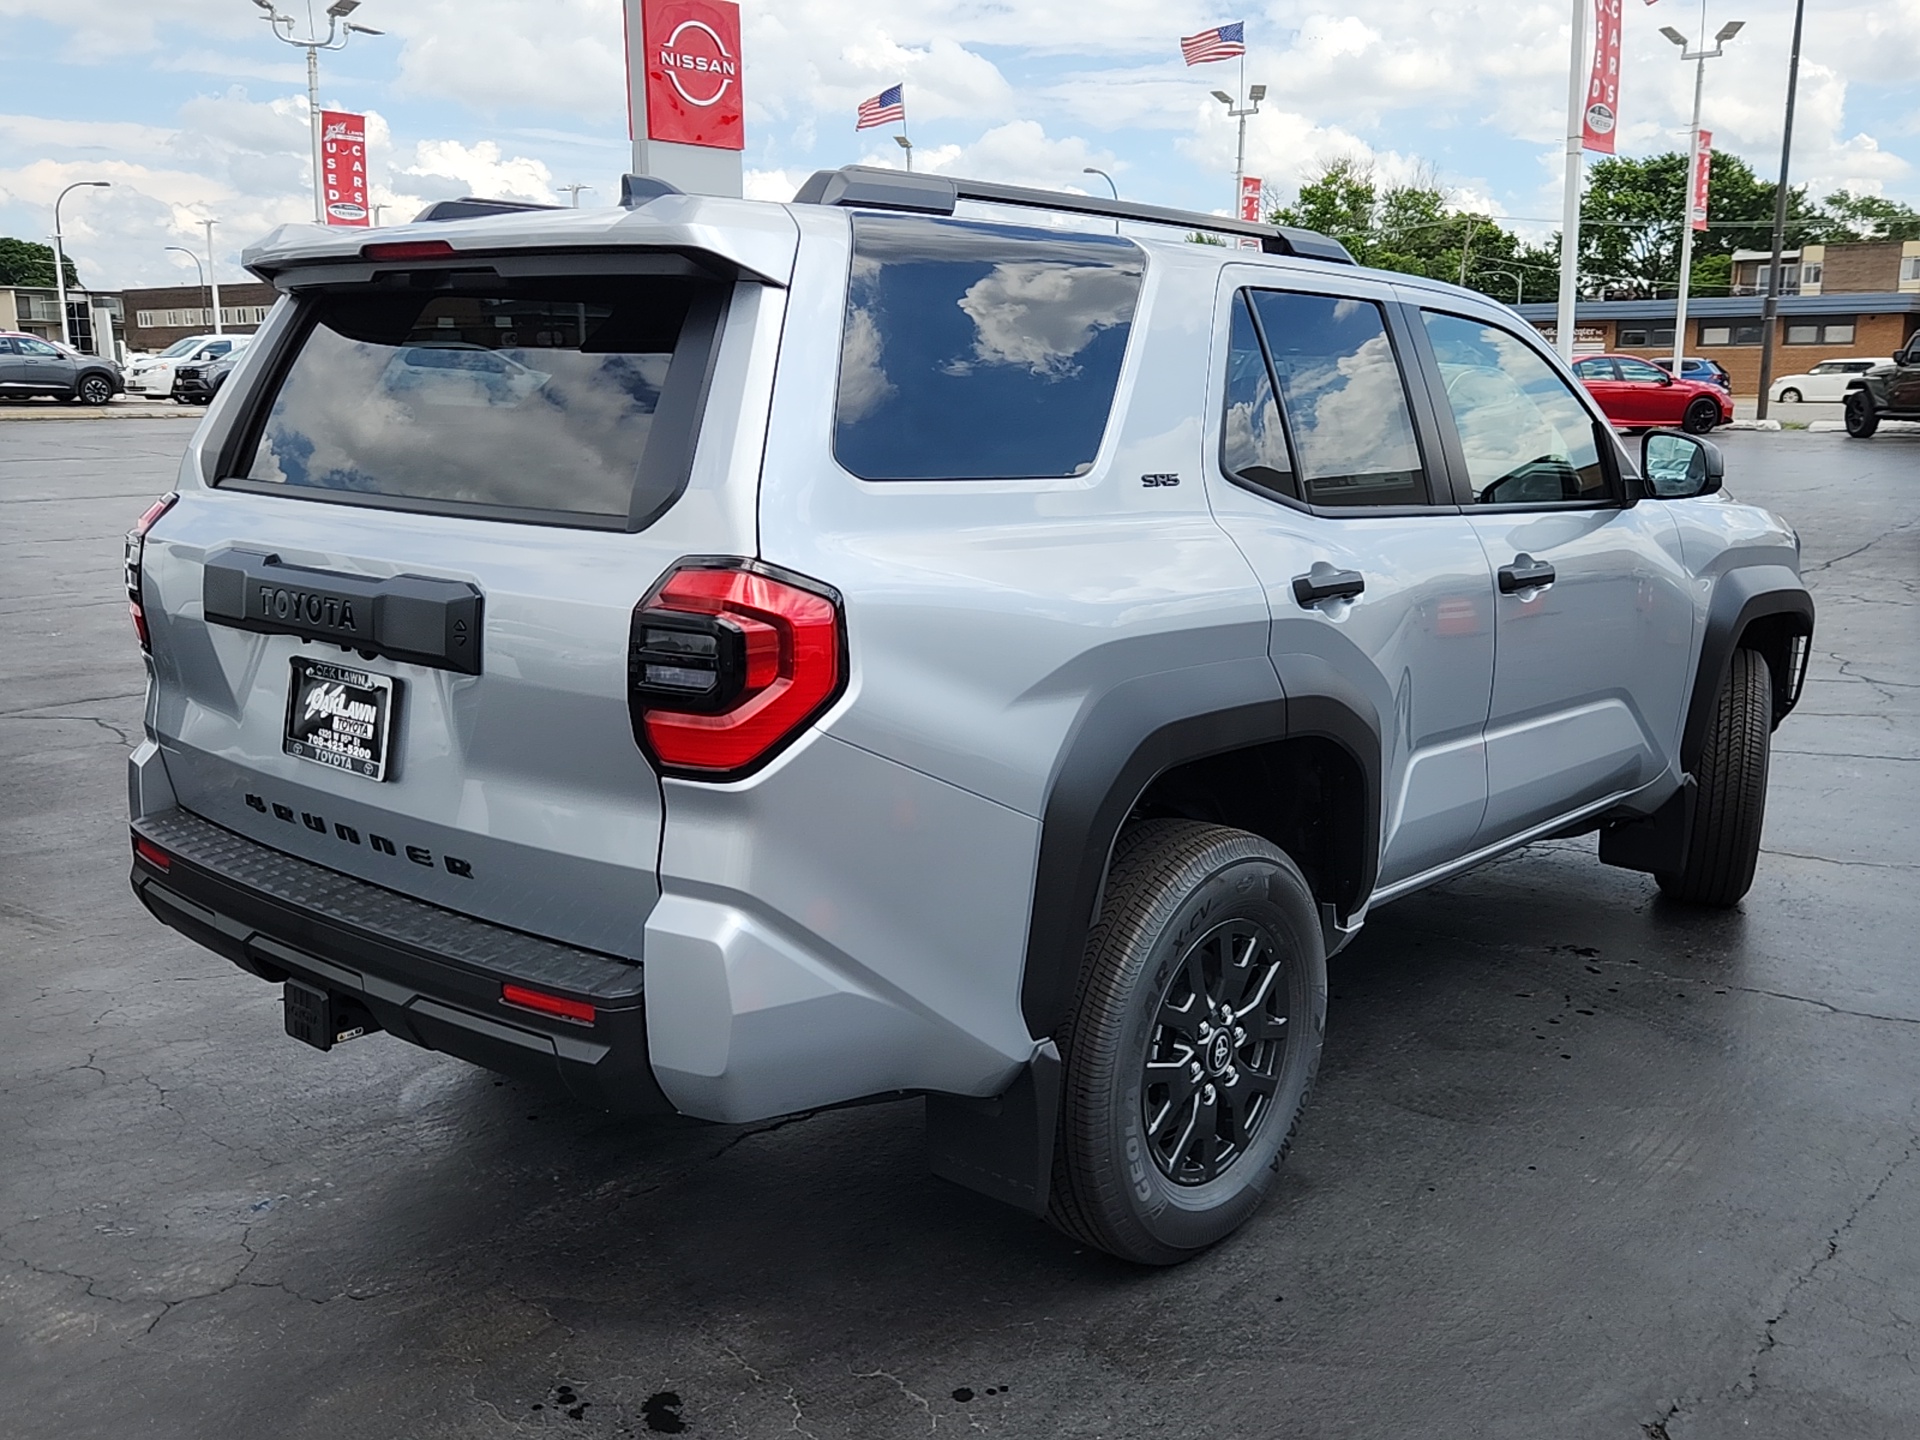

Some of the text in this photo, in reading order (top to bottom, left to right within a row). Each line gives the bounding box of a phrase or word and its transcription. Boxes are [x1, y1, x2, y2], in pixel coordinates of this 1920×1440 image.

[661, 51, 735, 75] NISSAN
[1607, 0, 1619, 103] CARS
[326, 142, 340, 200] USED
[352, 145, 363, 203] CARS
[1141, 473, 1180, 488] SR5
[259, 586, 357, 631] TOYOTA
[316, 664, 366, 685] OAK LAWN
[337, 719, 369, 737] TOYOTA
[307, 733, 372, 759] 708-423-5200
[315, 748, 353, 770] TOYOTA
[245, 793, 474, 879] 4RUNNER
